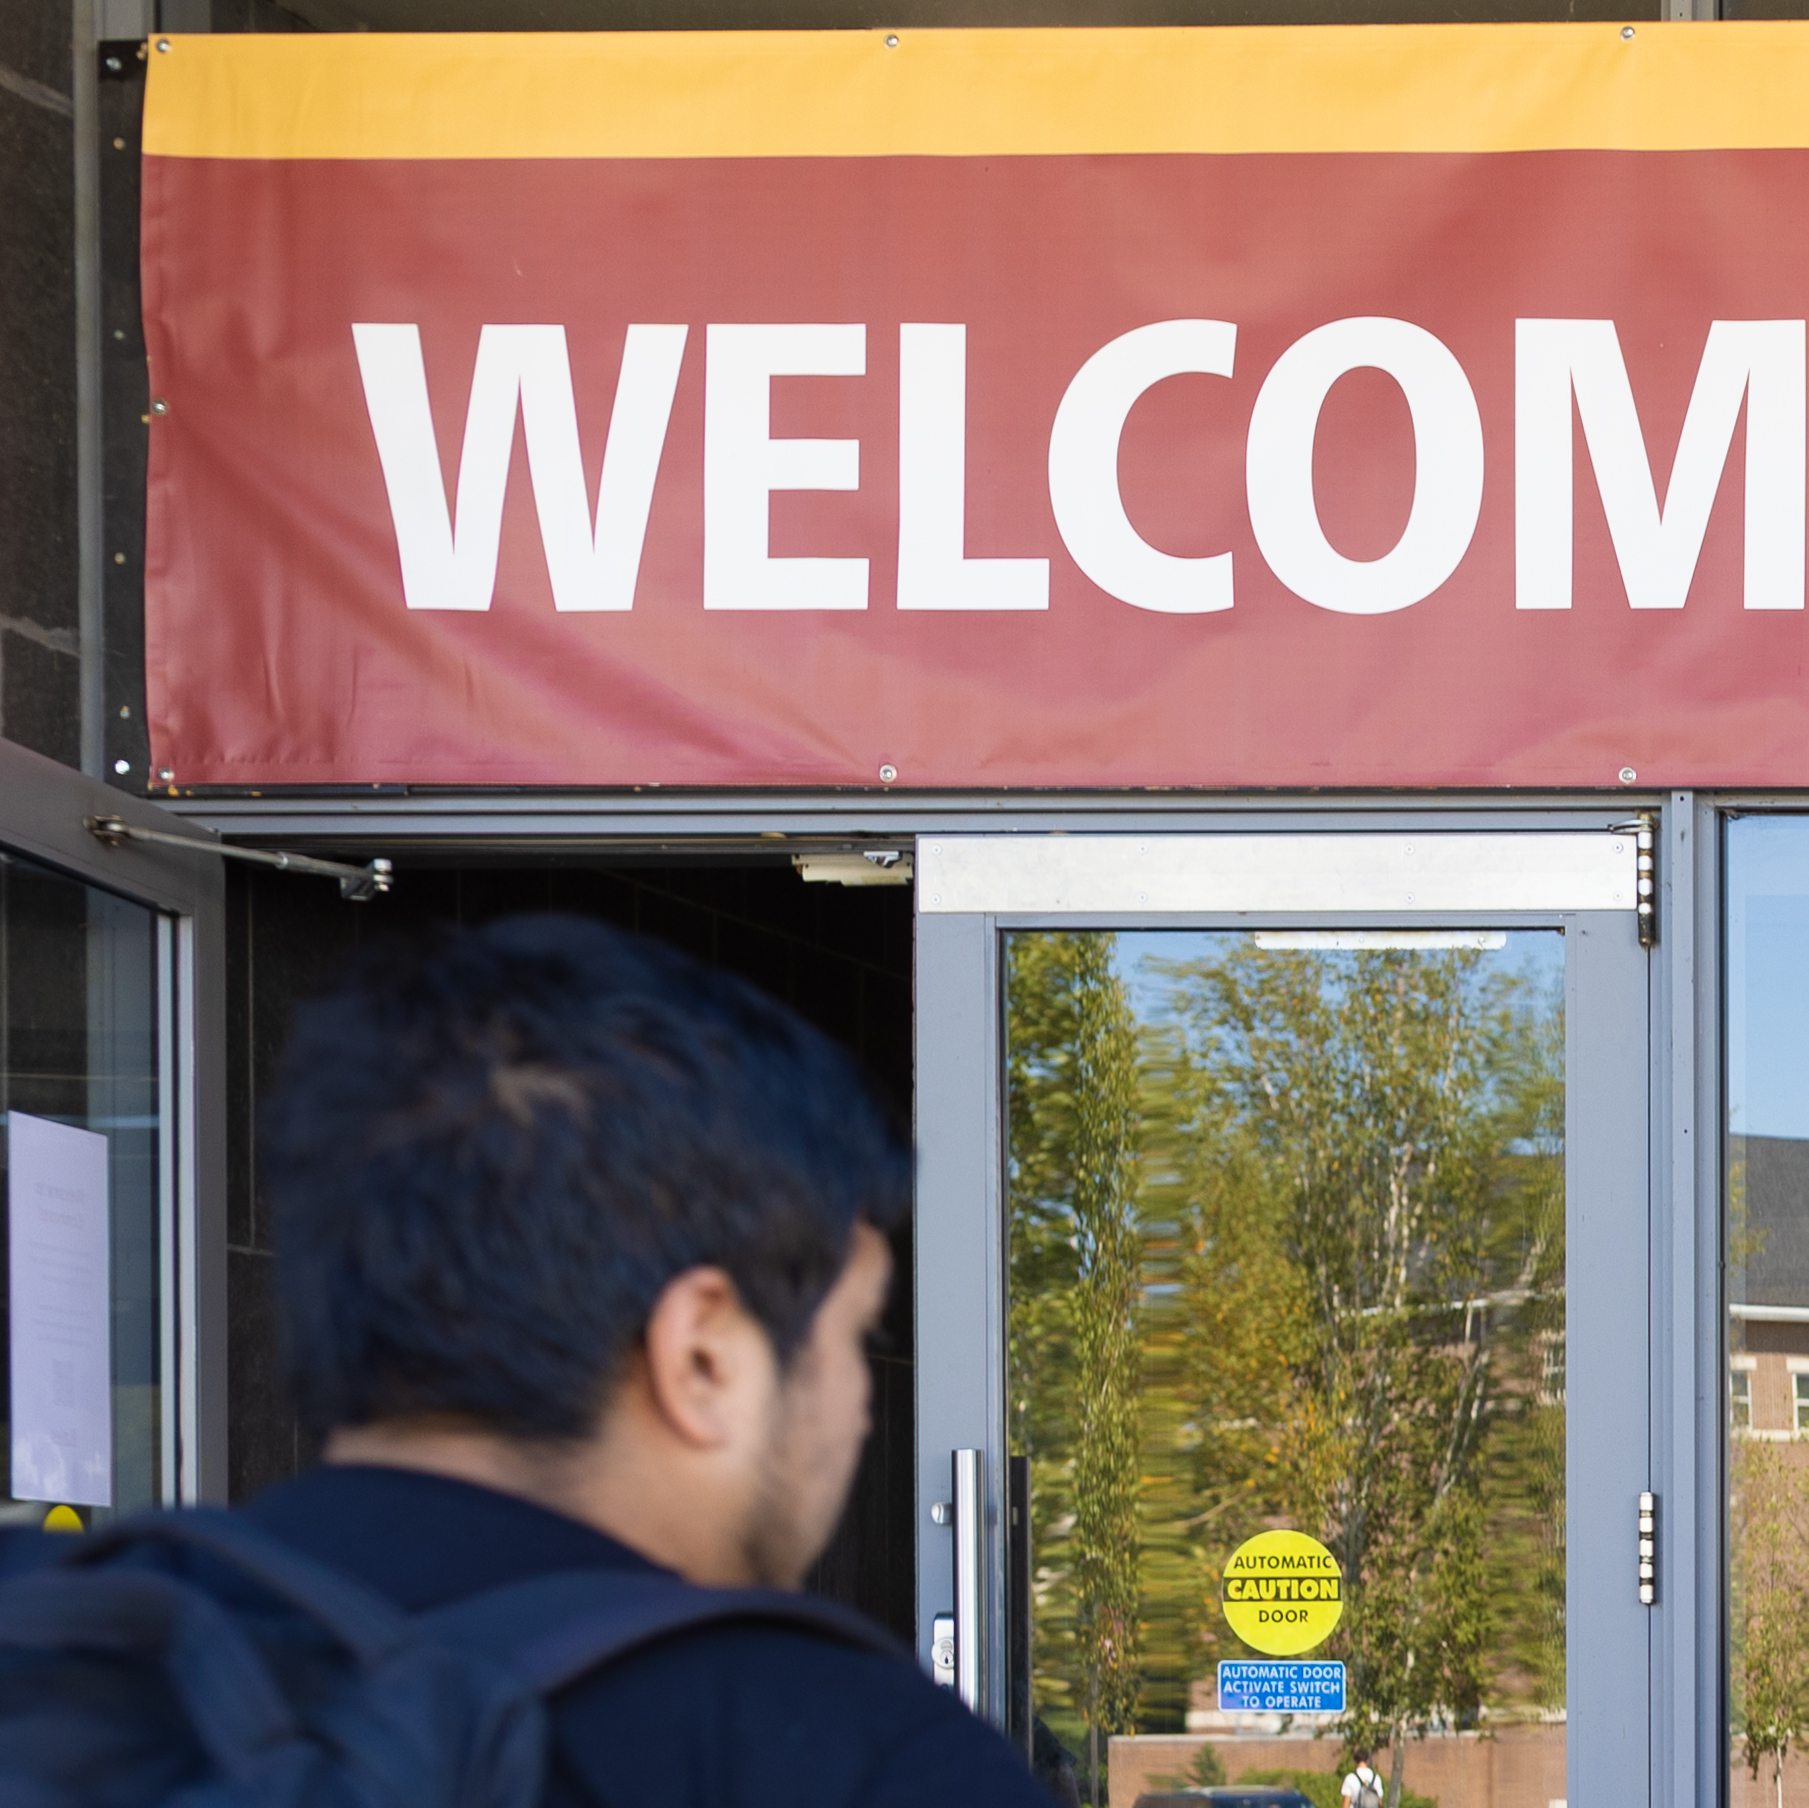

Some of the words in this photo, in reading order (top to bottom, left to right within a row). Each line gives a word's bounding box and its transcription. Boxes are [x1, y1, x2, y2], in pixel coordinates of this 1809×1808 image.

[1234, 1556, 1332, 1569] AUTOMATIC
[1227, 1579, 1338, 1600] CAUTION
[1259, 1610, 1308, 1623] DOOR
[1222, 1666, 1298, 1679] AUTOMATIC
[1303, 1666, 1341, 1679] DOOR
[1223, 1681, 1285, 1693] ACTIVATE
[1290, 1681, 1340, 1694] SWITCH
[1242, 1696, 1260, 1708] TO
[1265, 1696, 1321, 1708] OPERATE
